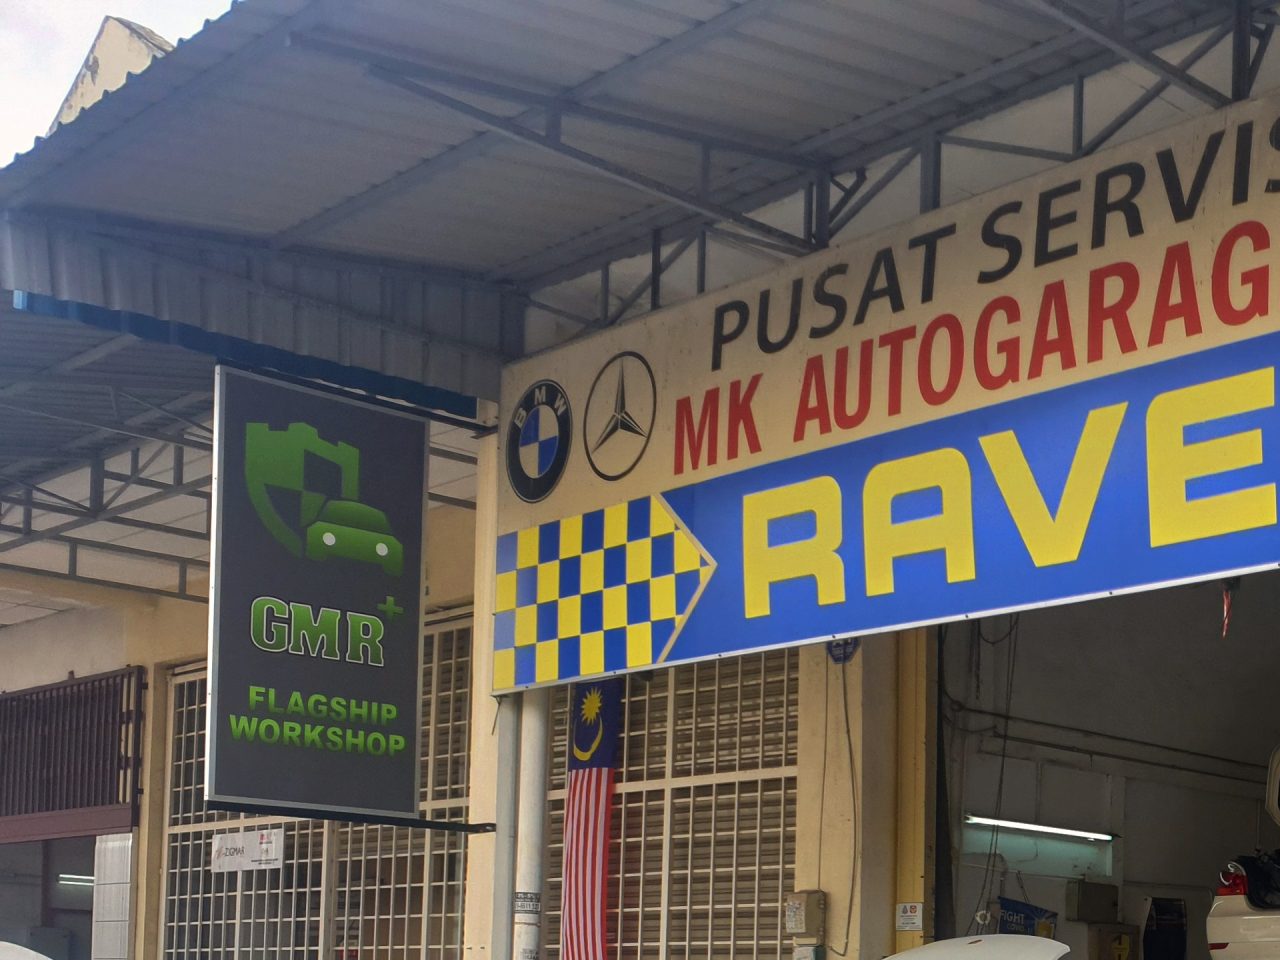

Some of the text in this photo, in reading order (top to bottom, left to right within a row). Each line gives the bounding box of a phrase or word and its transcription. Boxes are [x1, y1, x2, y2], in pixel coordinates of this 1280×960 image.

[711, 223, 956, 372] PUSAT
[514, 385, 567, 429] BMW
[673, 373, 763, 476] MK
[249, 685, 398, 726] FLAGSHIP
[229, 714, 406, 757] WORKSHOP
